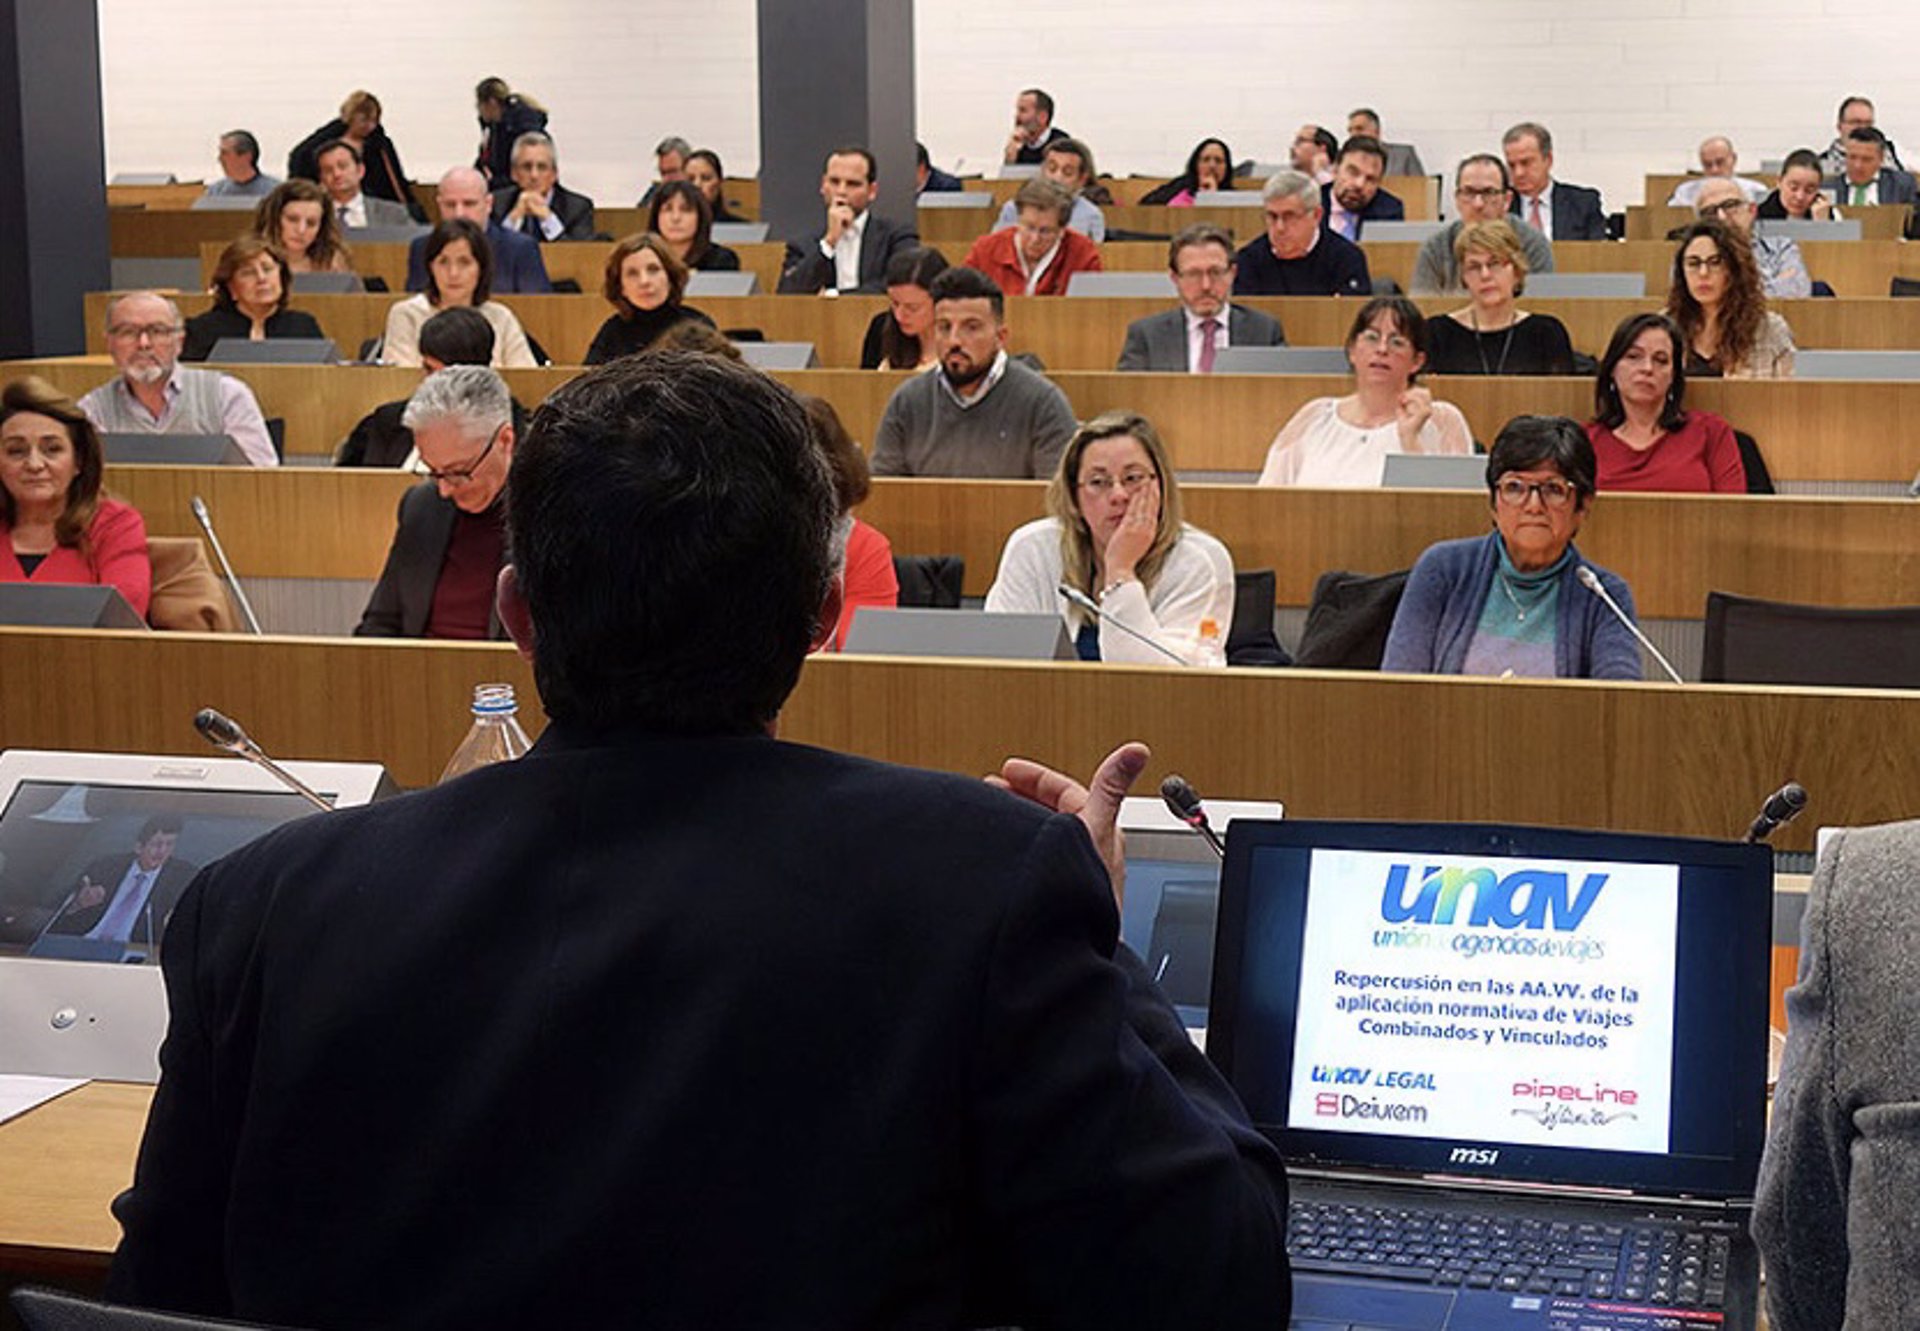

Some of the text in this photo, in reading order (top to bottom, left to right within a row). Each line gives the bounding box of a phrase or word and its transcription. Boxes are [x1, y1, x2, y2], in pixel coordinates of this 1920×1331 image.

[1380, 863, 1611, 932] unav
[1334, 969, 1639, 1004] Repercusión en las AA.VV. de la
[1335, 993, 1634, 1030] aplicación normativa de Viajes
[1358, 1018, 1608, 1050] Combinados y Vinculados
[1374, 1071, 1438, 1091] LEGAL
